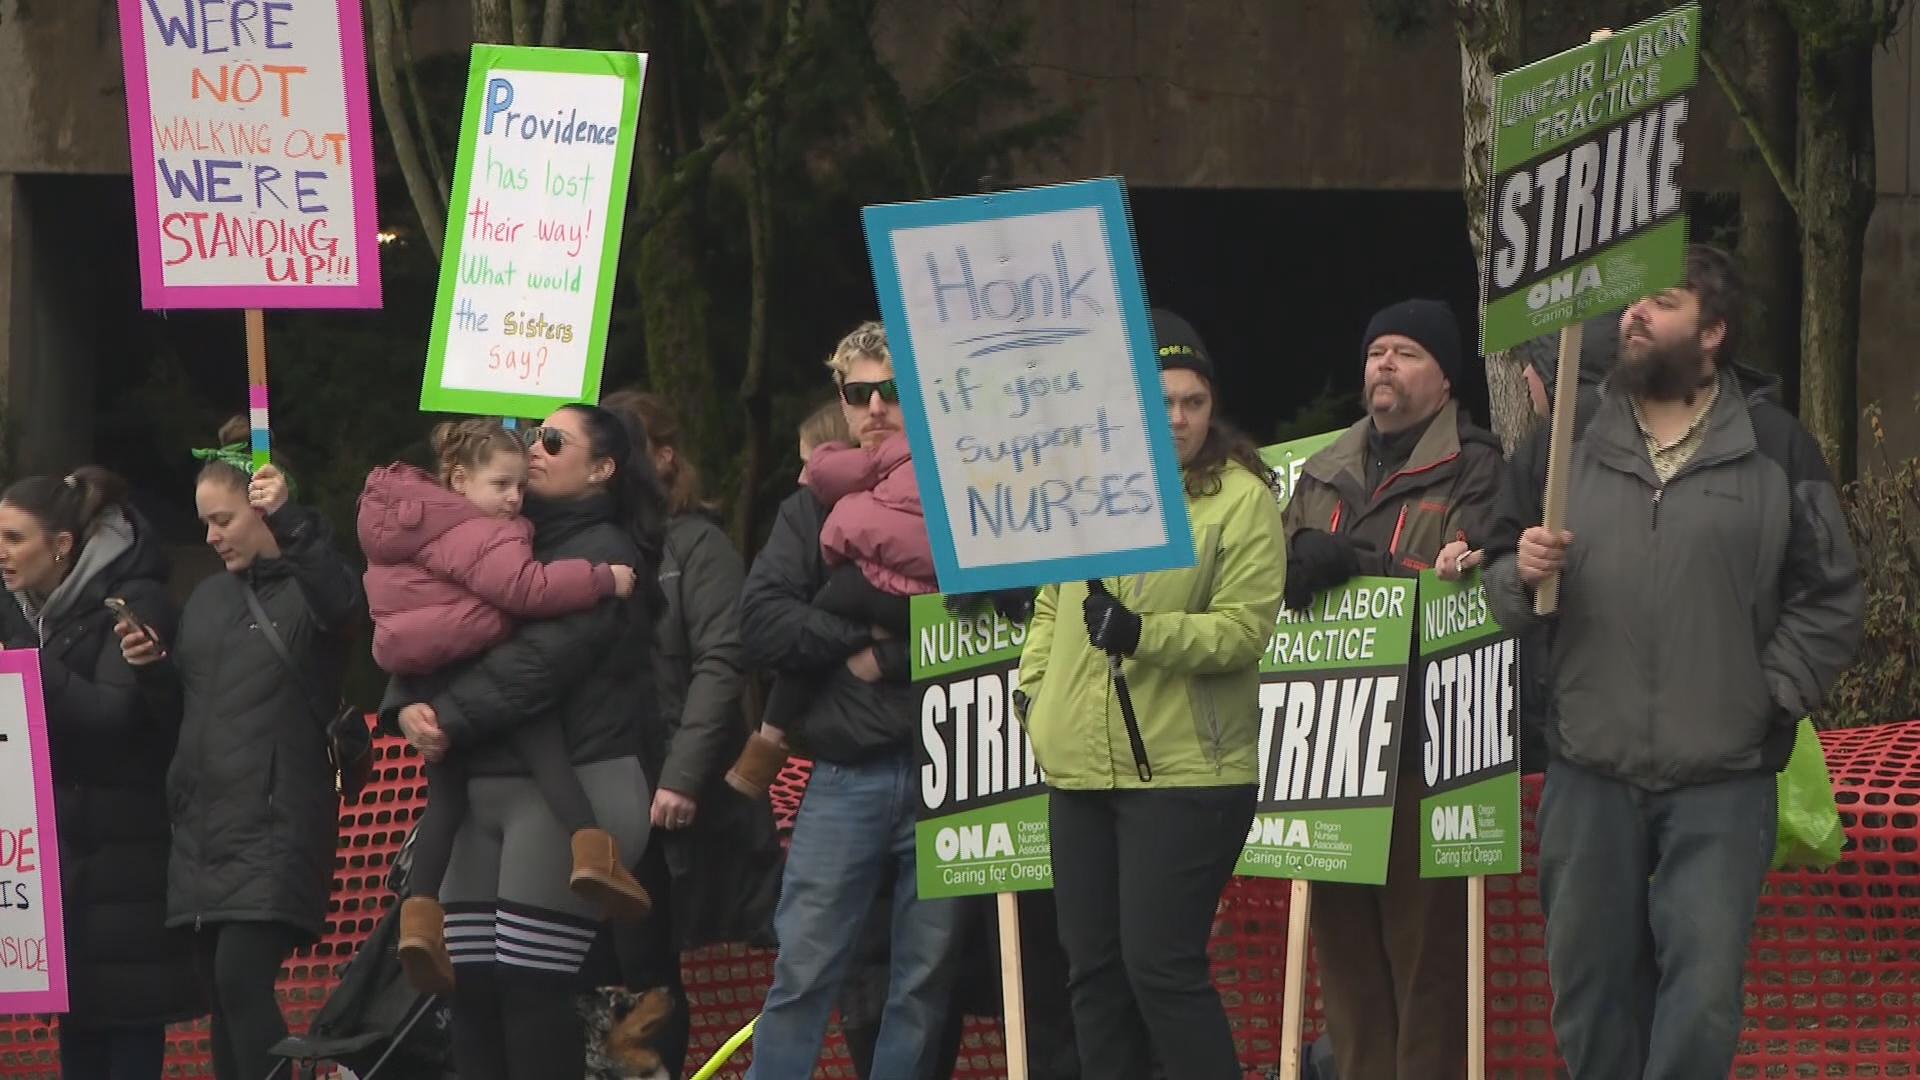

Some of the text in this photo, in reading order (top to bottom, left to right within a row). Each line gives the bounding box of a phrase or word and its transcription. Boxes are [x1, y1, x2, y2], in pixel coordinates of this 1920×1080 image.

[192, 64, 307, 117] NOT
[1501, 15, 1690, 128] UNFAIR LABOR
[484, 78, 617, 146] Providence
[1534, 63, 1662, 150] PRACTICE
[153, 115, 346, 164] WALKING OUT
[487, 145, 594, 203] has lost
[1494, 96, 1688, 289] STRIKE
[162, 212, 339, 266] STANDING
[468, 197, 592, 257] their way!
[462, 252, 582, 294] What would
[926, 241, 1104, 323] Honk
[1526, 264, 1602, 310] ONA
[456, 297, 489, 333] the
[934, 367, 1086, 418] if you
[955, 405, 1125, 472] support
[967, 471, 1153, 538] NURSES
[1323, 586, 1405, 621] LABOR
[1425, 585, 1487, 642] NURSES
[920, 610, 1026, 667] NURSES
[921, 668, 1046, 809] STRI
[1424, 639, 1514, 787] STRIKE
[935, 822, 1015, 862] ONA
[1017, 821, 1048, 833] Oregon
[1018, 834, 1046, 844] Nurses
[1431, 805, 1477, 842] ONA
[943, 867, 985, 885] Caring
[989, 864, 1007, 880] for
[1244, 849, 1347, 872] Caring for Oregon
[1435, 846, 1502, 867] Caring for Oregon
